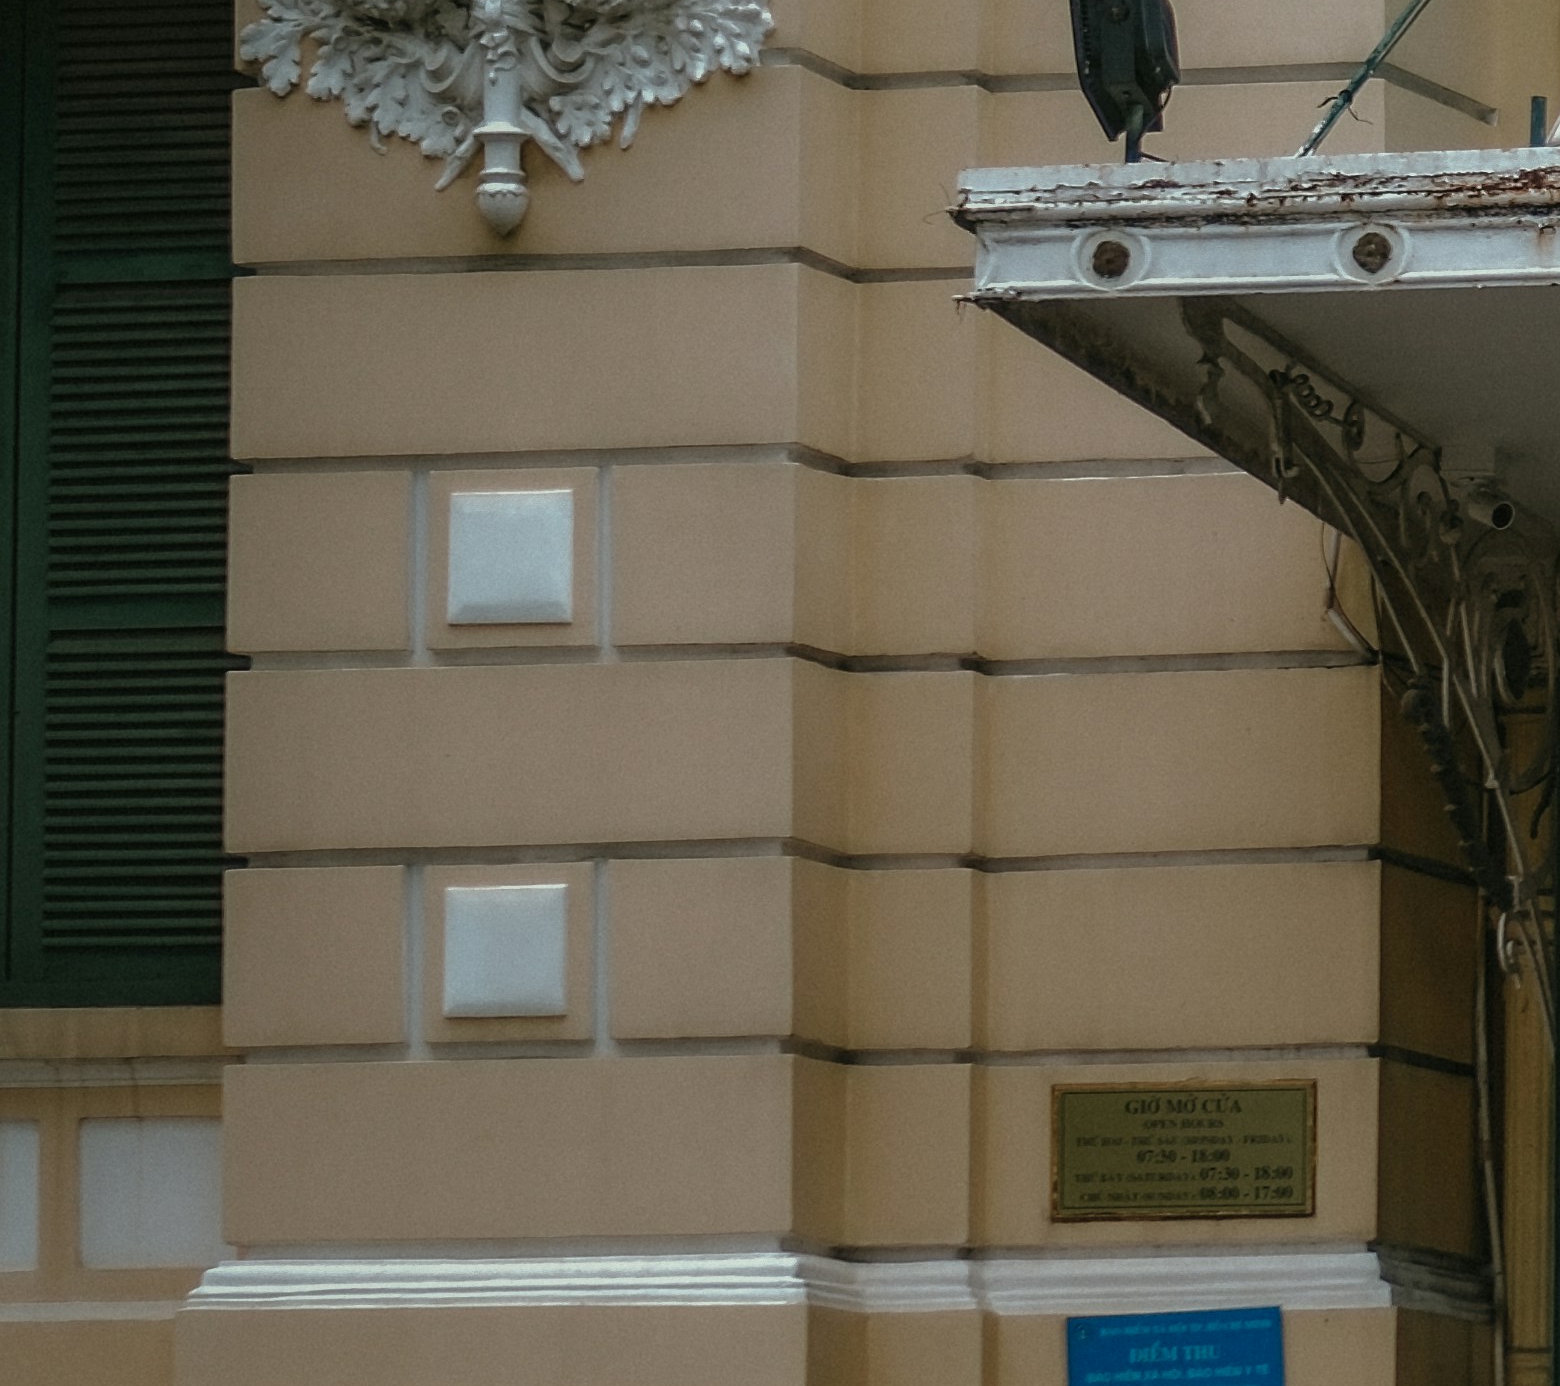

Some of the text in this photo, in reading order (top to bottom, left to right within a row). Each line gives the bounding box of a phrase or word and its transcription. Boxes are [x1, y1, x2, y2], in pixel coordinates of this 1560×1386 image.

[1136, 1149, 1178, 1164] 07:30
[1191, 1148, 1231, 1163] 18:00
[1199, 1166, 1241, 1181] 07:30
[1254, 1166, 1294, 1180] 18:00
[1199, 1186, 1241, 1201] 08:00
[1254, 1185, 1294, 1200] 17:00
[1129, 1340, 1221, 1364] ĐIỂM THU
